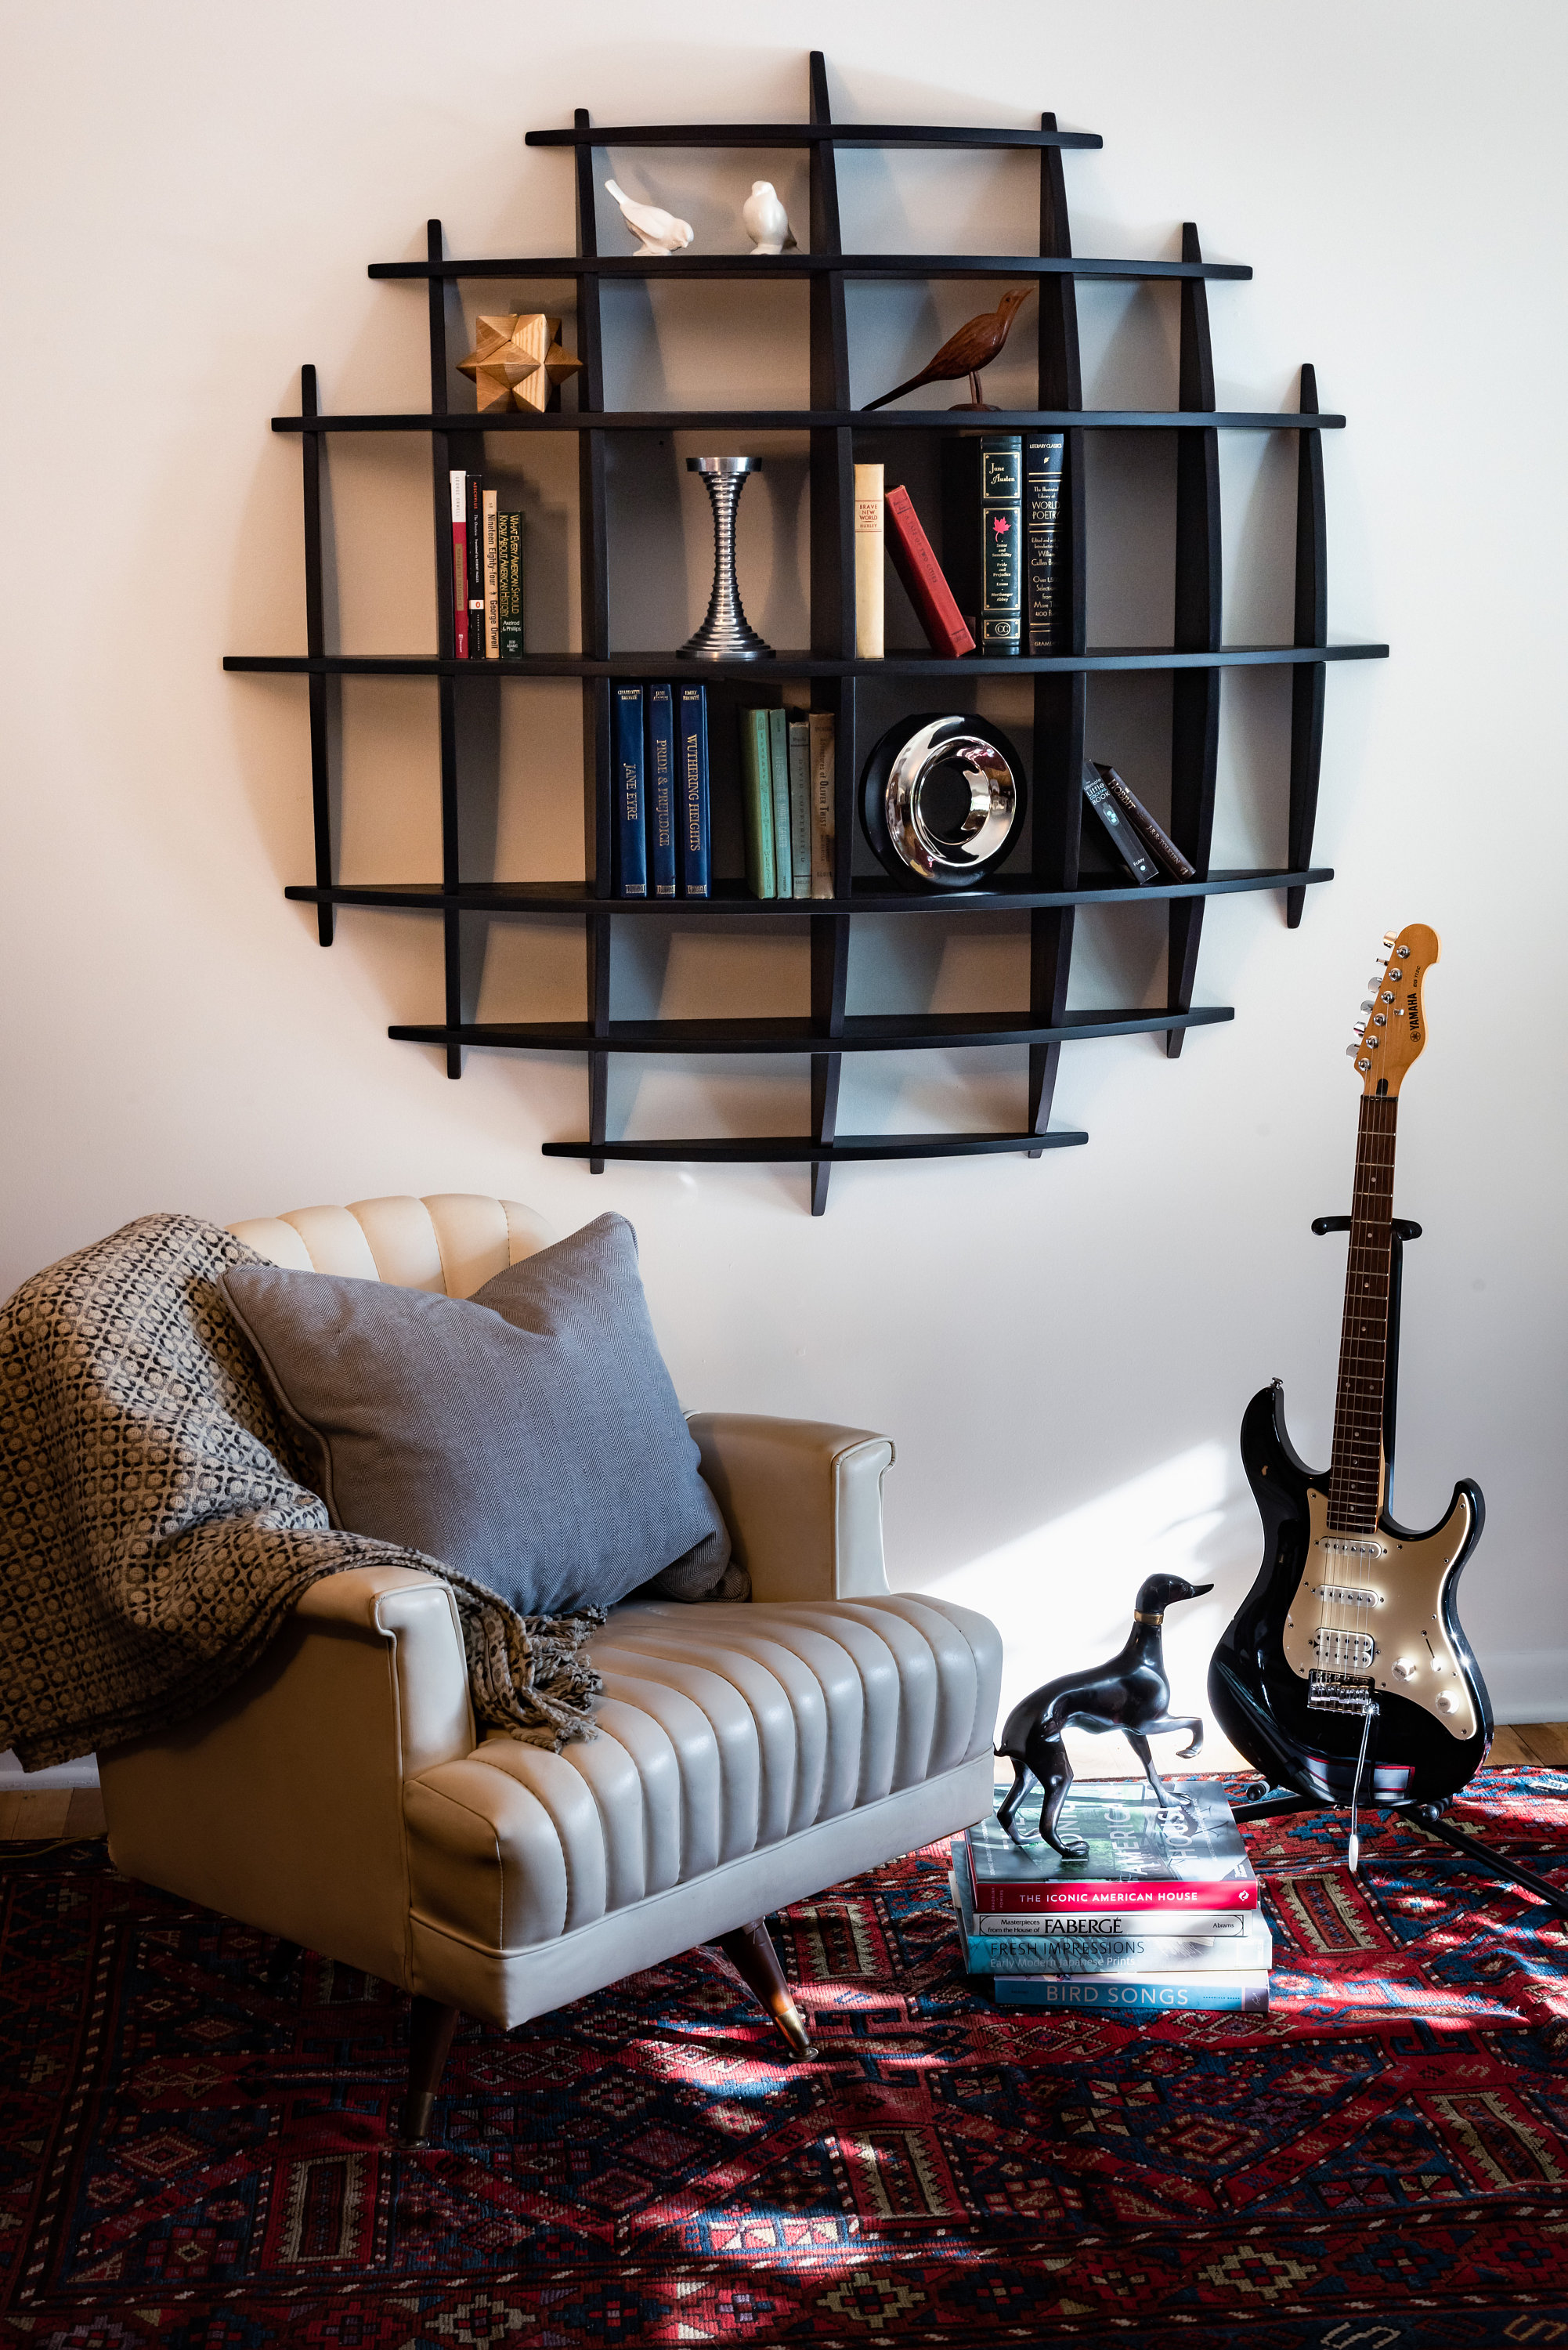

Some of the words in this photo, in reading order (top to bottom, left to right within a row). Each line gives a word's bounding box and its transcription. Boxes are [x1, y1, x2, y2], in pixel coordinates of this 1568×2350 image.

[989, 463, 1004, 474] Jane
[991, 474, 1015, 484] Austen
[510, 515, 518, 534] WHAT
[1032, 511, 1060, 519] POETRY
[499, 515, 508, 537] KNOW
[500, 538, 508, 559] ABOUT
[510, 535, 518, 555] EVERY
[487, 548, 497, 586] Eighty-four
[500, 560, 509, 591] AMERICAN
[511, 555, 519, 587] AMERICAN
[500, 592, 509, 617] HISTORY
[511, 588, 520, 614] SHOULD
[489, 600, 497, 624] George
[656, 739, 667, 773] PRIDE
[623, 763, 636, 790] JANE
[687, 734, 699, 801] WUTHERING
[658, 776, 668, 785] &
[1084, 779, 1101, 790] Ultimate
[1087, 783, 1104, 796] Little
[819, 781, 829, 804] OLIVER
[1092, 791, 1110, 805] BOOK
[1108, 779, 1136, 809] HOBBIT
[627, 793, 637, 820] EYRE
[656, 788, 670, 846] PREJUDICE
[820, 806, 829, 827] TWIST
[689, 804, 700, 851] HEIGHTS
[1133, 858, 1145, 866] Foley
[1159, 839, 1180, 864] TOLKIEN
[1407, 992, 1419, 1031] YAMAHA
[1046, 1893, 1088, 1902] ICONIC
[1093, 1893, 1153, 1902] AMERICAN
[1158, 1893, 1198, 1901] HOUSE
[1045, 1917, 1122, 1933] FABERGÉ
[991, 1943, 1037, 1955] FRESH
[1044, 1941, 1144, 1954] IMPRESSIONS
[991, 1959, 1014, 1969] Early
[1018, 1958, 1057, 1968] Modern
[1059, 1958, 1104, 1969] Japanese
[1107, 1957, 1135, 1966] Prints
[1047, 1986, 1098, 2002] BIRD
[1107, 1987, 1188, 2005] SONGS
